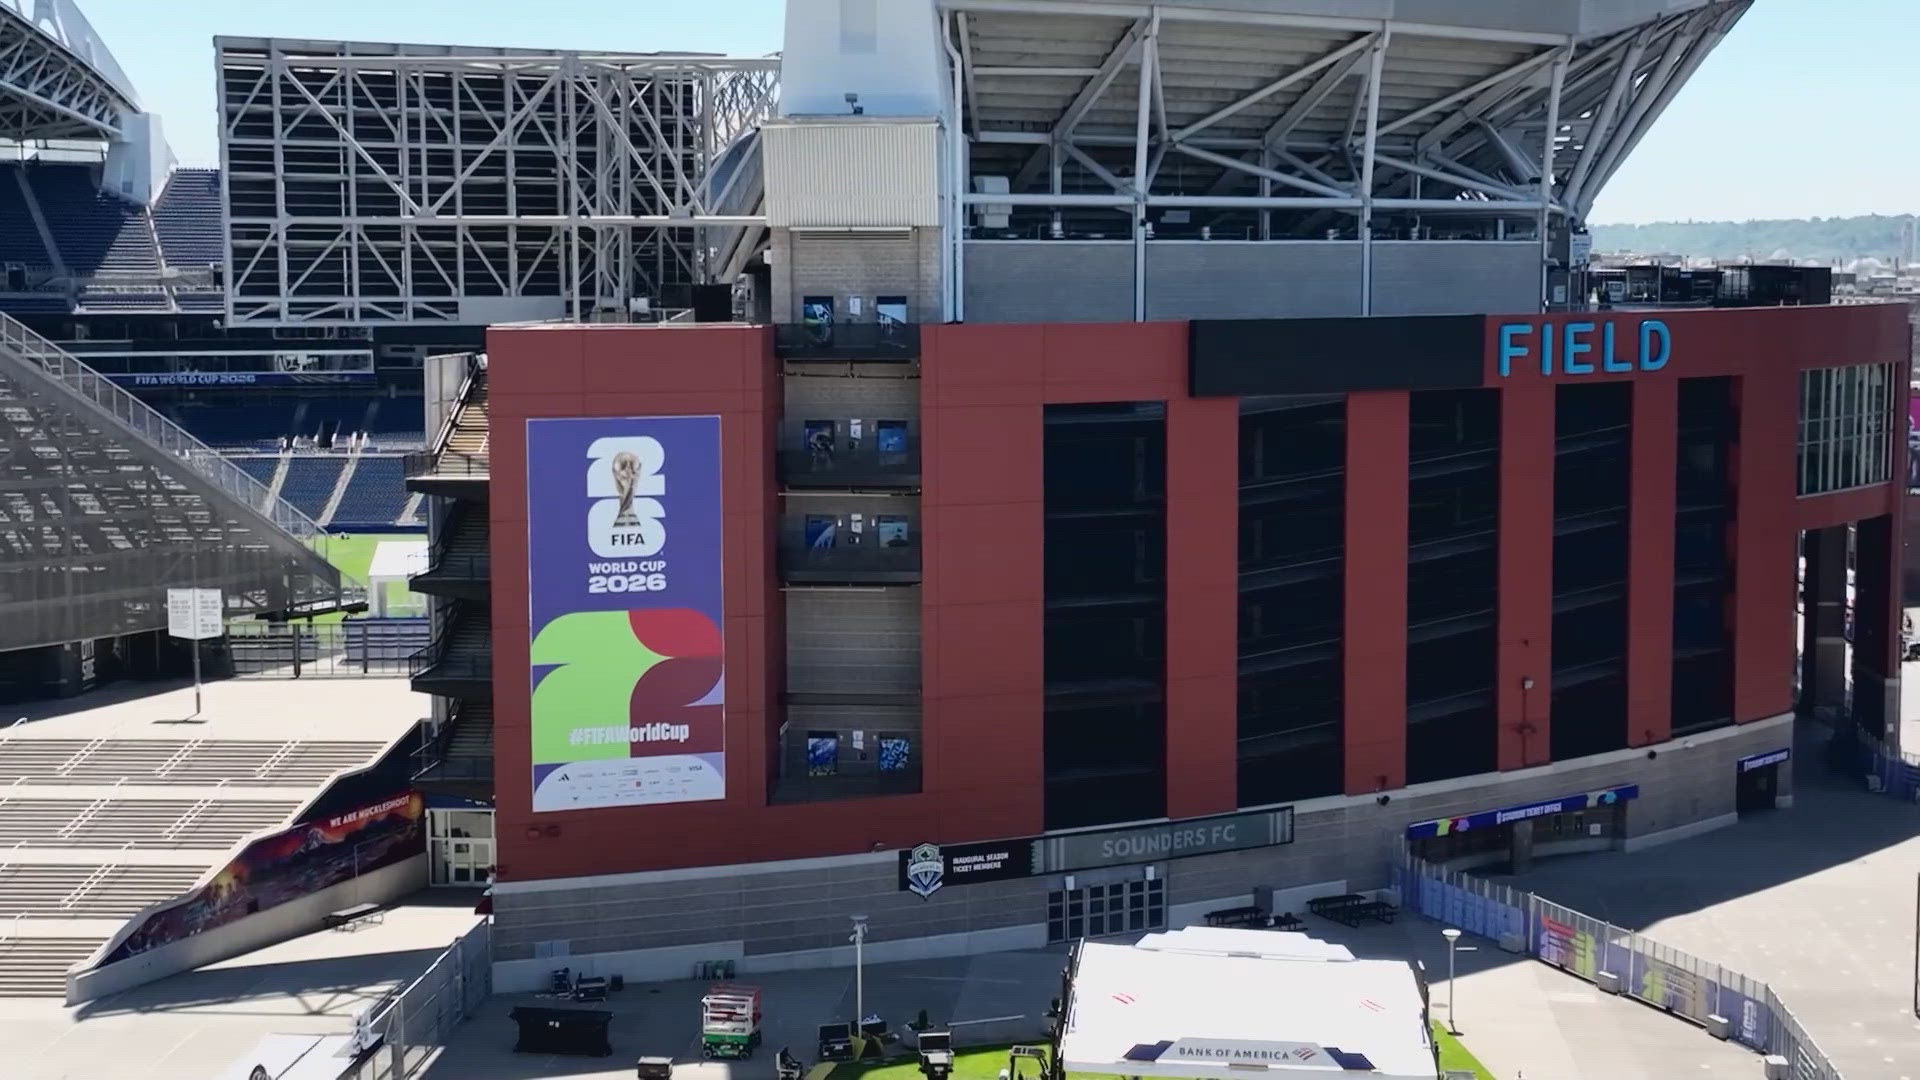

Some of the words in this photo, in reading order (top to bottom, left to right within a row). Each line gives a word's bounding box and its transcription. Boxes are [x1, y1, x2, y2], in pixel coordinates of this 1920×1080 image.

[1499, 319, 1671, 377] FIELD
[135, 376, 158, 385] FIFA
[158, 376, 196, 385] WORLD
[199, 375, 218, 384] CUP
[219, 374, 256, 384] 2026
[611, 533, 645, 546] FIFA
[588, 562, 637, 575] WORLD
[639, 560, 666, 572] CUP
[588, 573, 666, 594] 2026
[568, 722, 689, 745] #FIFAWorldCup
[329, 816, 342, 828] WE
[343, 812, 358, 825] ARE
[358, 795, 410, 818] MUCKLESHOOT
[1102, 827, 1207, 858] SOUNDERS
[1211, 824, 1237, 844] FC
[952, 854, 985, 865] INAUGURAL
[986, 852, 1009, 862] SEASON
[952, 865, 972, 873] TICKET
[973, 861, 1001, 871] MEMBERS
[1178, 1047, 1211, 1056] BANK
[1215, 1049, 1230, 1057] OF
[1234, 1049, 1289, 1060] AMERICA
